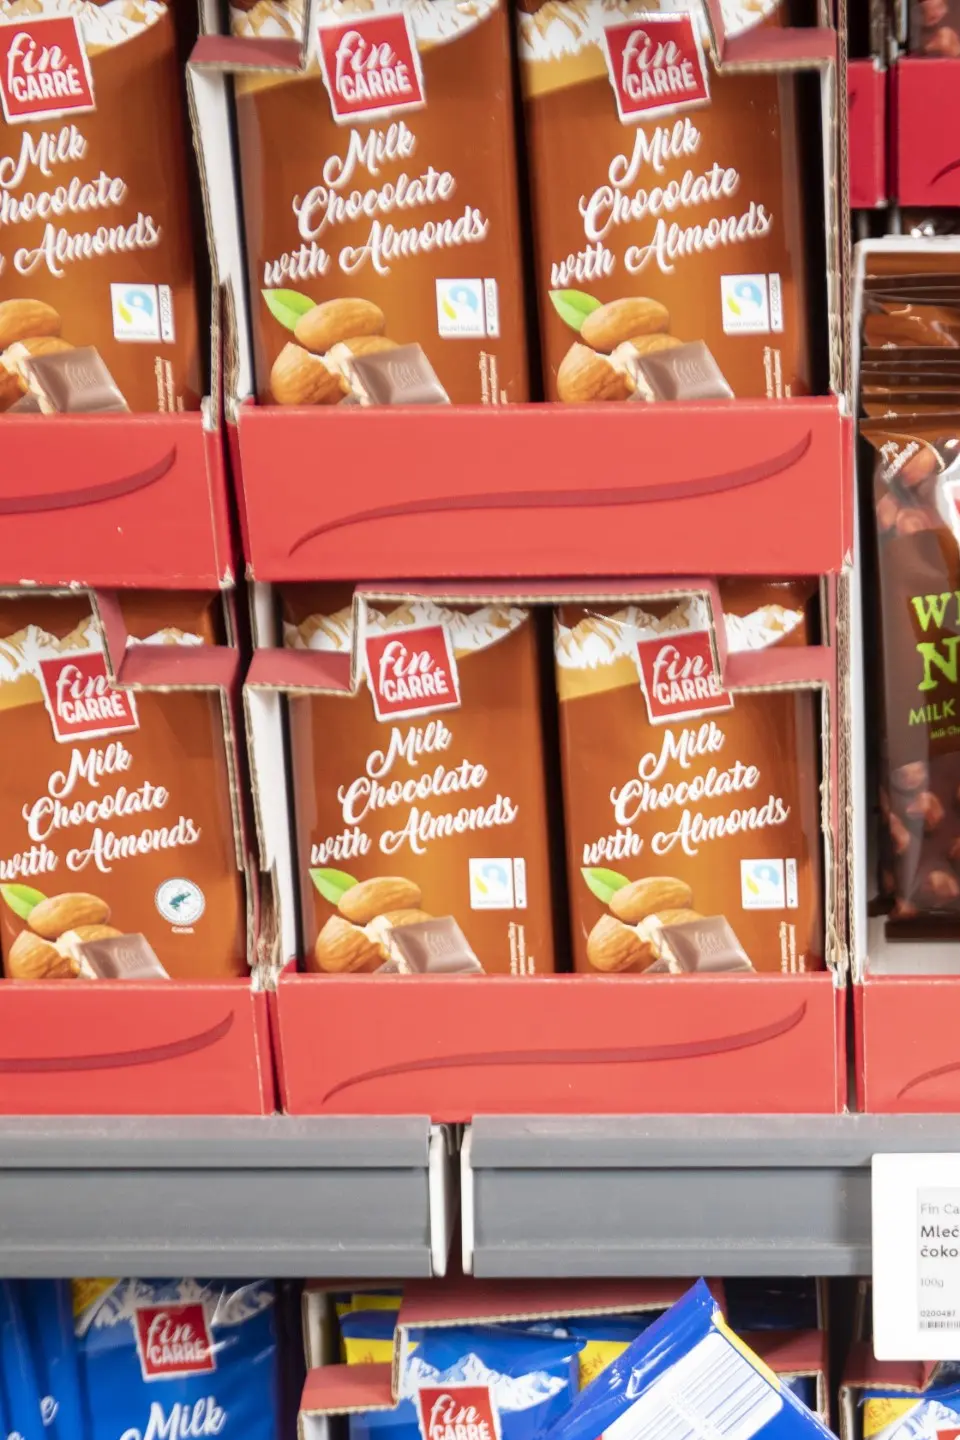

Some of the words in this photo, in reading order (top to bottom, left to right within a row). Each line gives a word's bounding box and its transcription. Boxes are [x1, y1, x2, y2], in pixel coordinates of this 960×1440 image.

[7, 32, 67, 93] fin
[12, 64, 83, 102] CARRÉ
[336, 30, 396, 94] fin
[340, 61, 412, 102] CARRÉ
[622, 30, 682, 92] fin
[626, 58, 697, 99] CARRÉ
[0, 125, 88, 188] Milk
[323, 121, 416, 189] Milk
[609, 117, 701, 187] Milk
[0, 171, 126, 226] hocolate
[292, 166, 456, 241] Chocolate
[579, 162, 739, 241] Chocolate
[14, 213, 161, 277] Almonds
[264, 241, 330, 287] with
[338, 206, 489, 276] Almonds
[551, 242, 616, 287] with
[624, 201, 773, 273] Almonds
[57, 665, 108, 719] fin
[380, 640, 435, 695] fin
[383, 667, 449, 702] CARRÉ
[652, 645, 709, 698] fin
[62, 690, 126, 724] CARRÉ
[48, 741, 133, 798] Milk
[366, 720, 452, 778] Milk
[638, 721, 725, 780] Milk
[22, 781, 169, 842] Chocolate
[337, 758, 487, 825] Chocolate
[610, 761, 760, 826] Chocolate
[0, 844, 57, 880] with
[66, 816, 201, 872] Almonds
[311, 826, 372, 865] with
[379, 794, 518, 854] Almonds
[583, 826, 643, 865] with
[651, 796, 791, 855] Almonds
[921, 1203, 939, 1215] Fin
[149, 1313, 194, 1358] fin
[429, 1394, 479, 1437] fin
